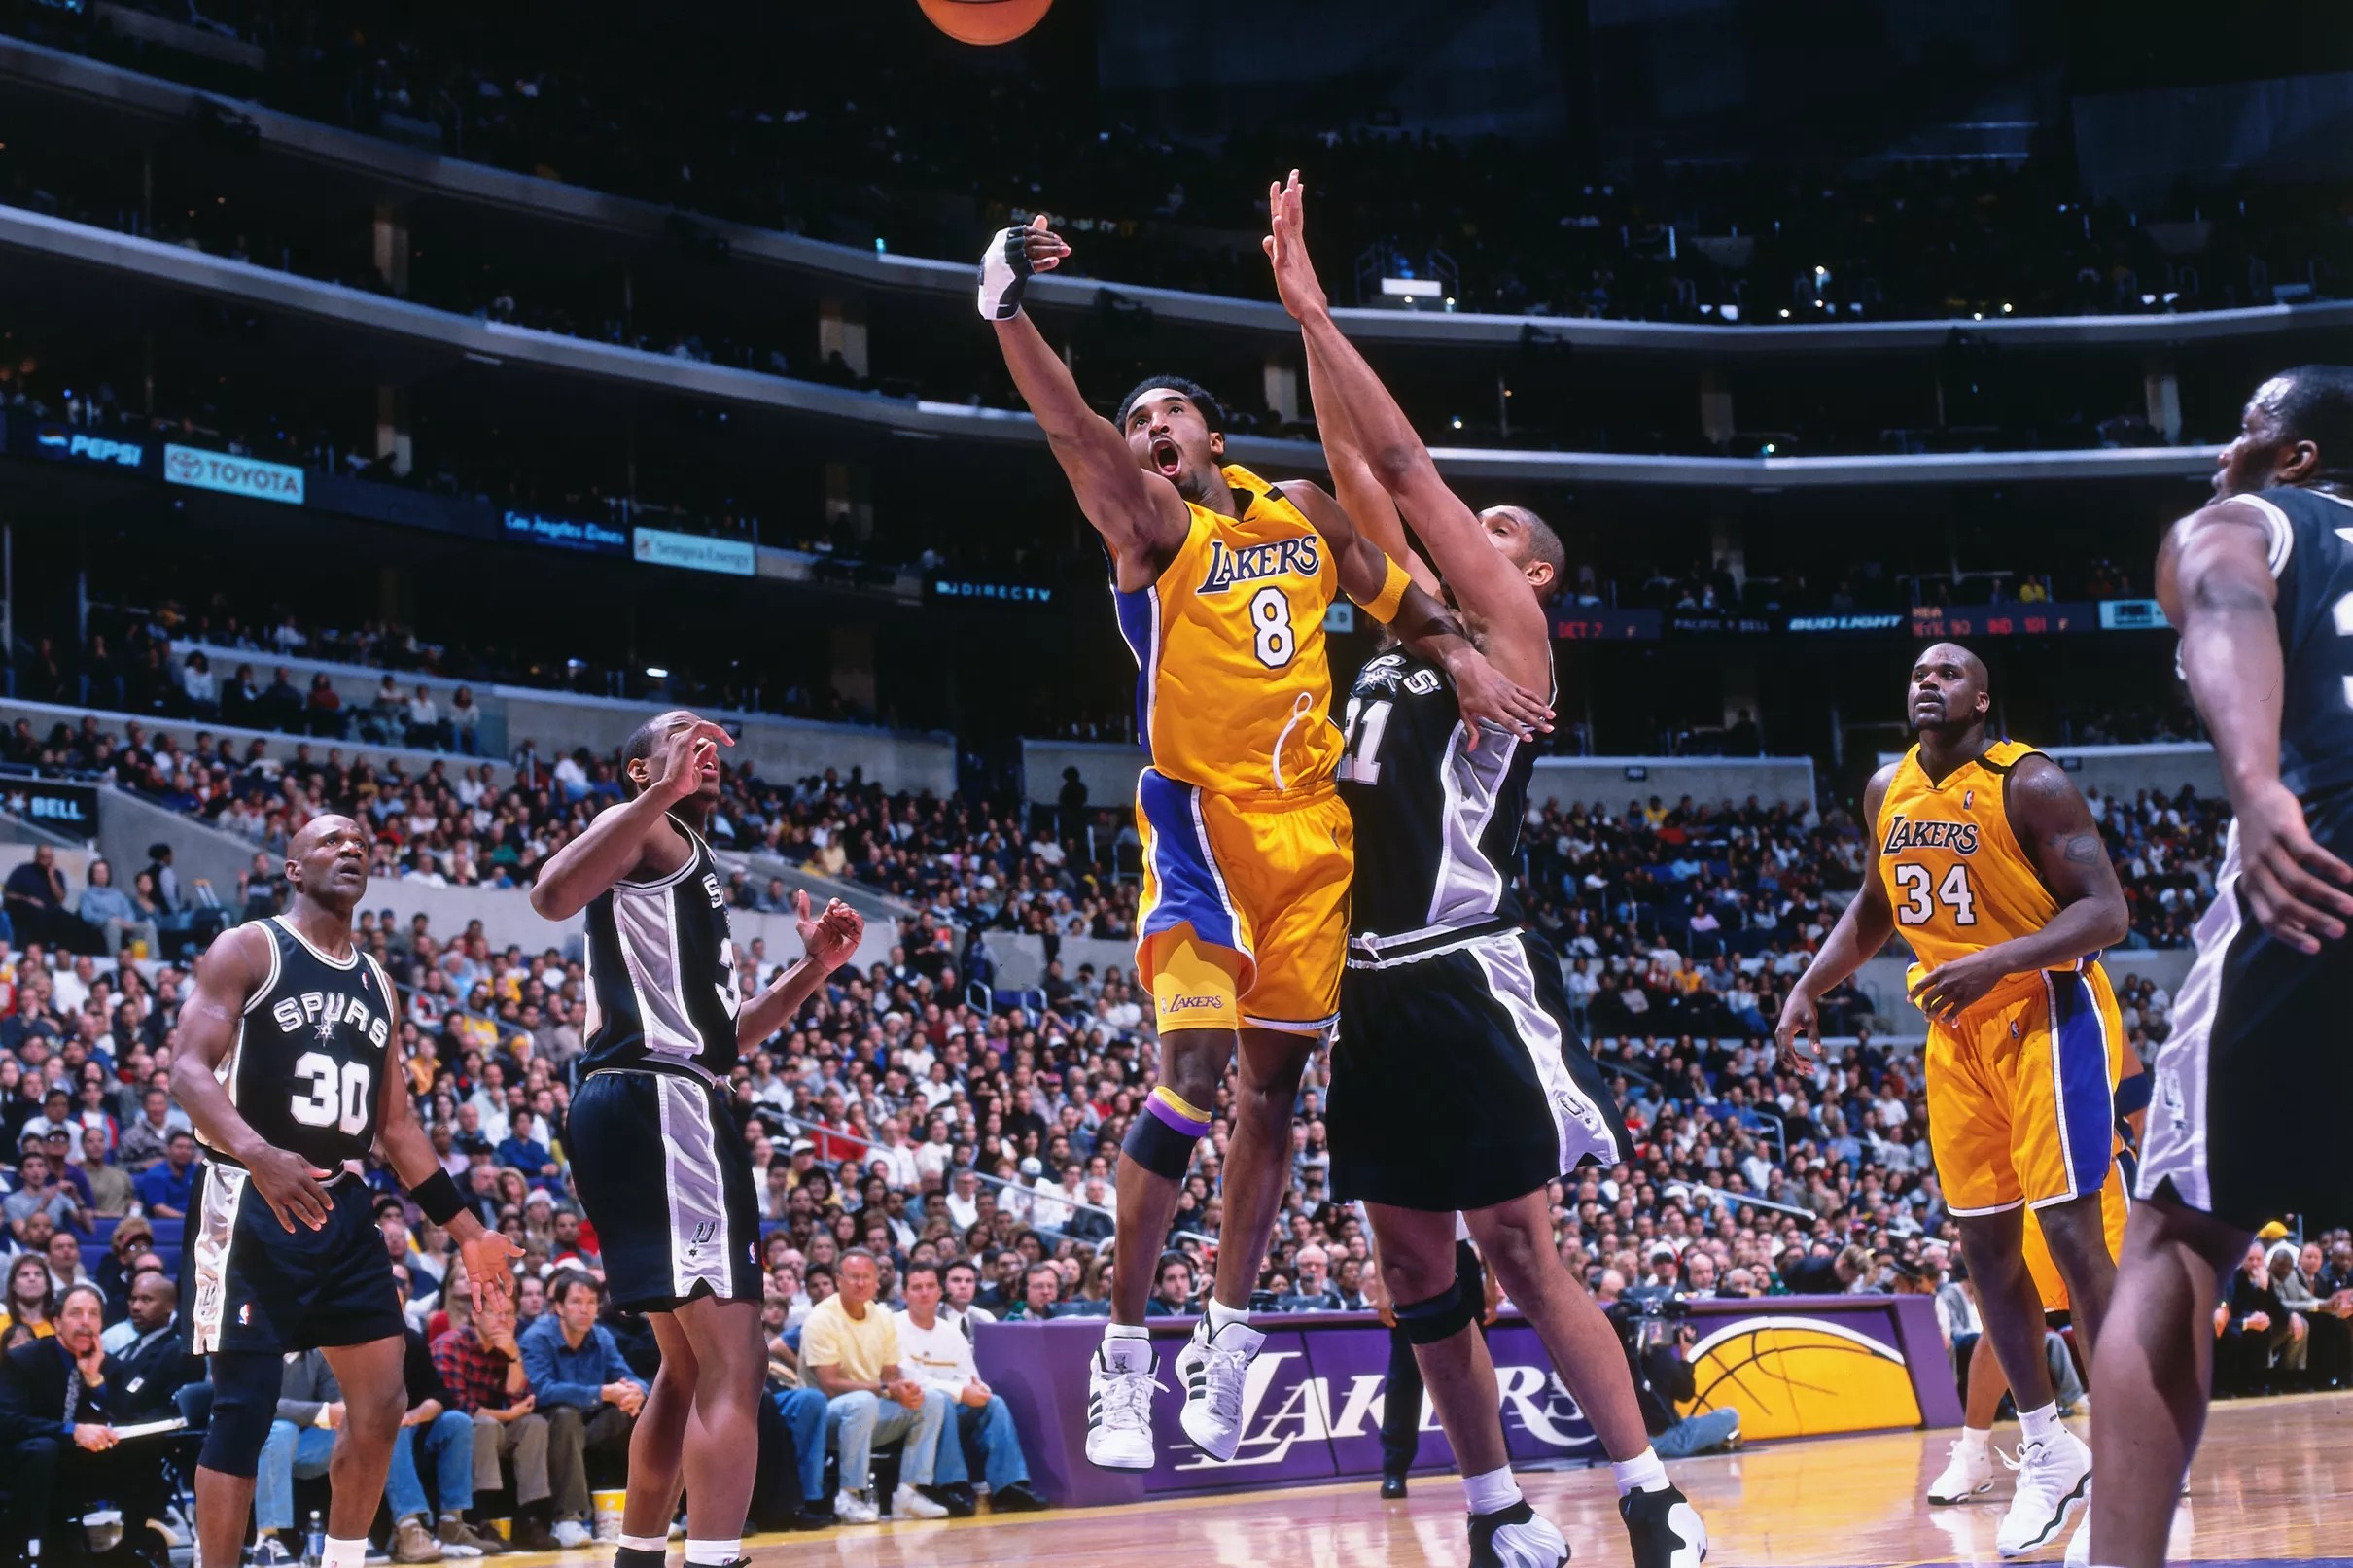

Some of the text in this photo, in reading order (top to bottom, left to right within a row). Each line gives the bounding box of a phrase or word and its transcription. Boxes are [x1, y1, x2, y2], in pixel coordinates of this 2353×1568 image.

[70, 435, 142, 467] PEPSI
[209, 460, 300, 494] TOYOTA
[1195, 534, 1320, 596] LAKERS
[1248, 585, 1295, 670] 8
[1789, 613, 1904, 631] BUD LIGHT
[31, 797, 86, 820] BELL
[1881, 814, 1979, 855] LAKERS
[1894, 862, 1977, 926] 34
[273, 992, 388, 1049] SPURS
[1169, 993, 1225, 1013] LAKERS
[290, 1051, 370, 1136] 30
[1169, 1351, 1599, 1472] LAKRS
